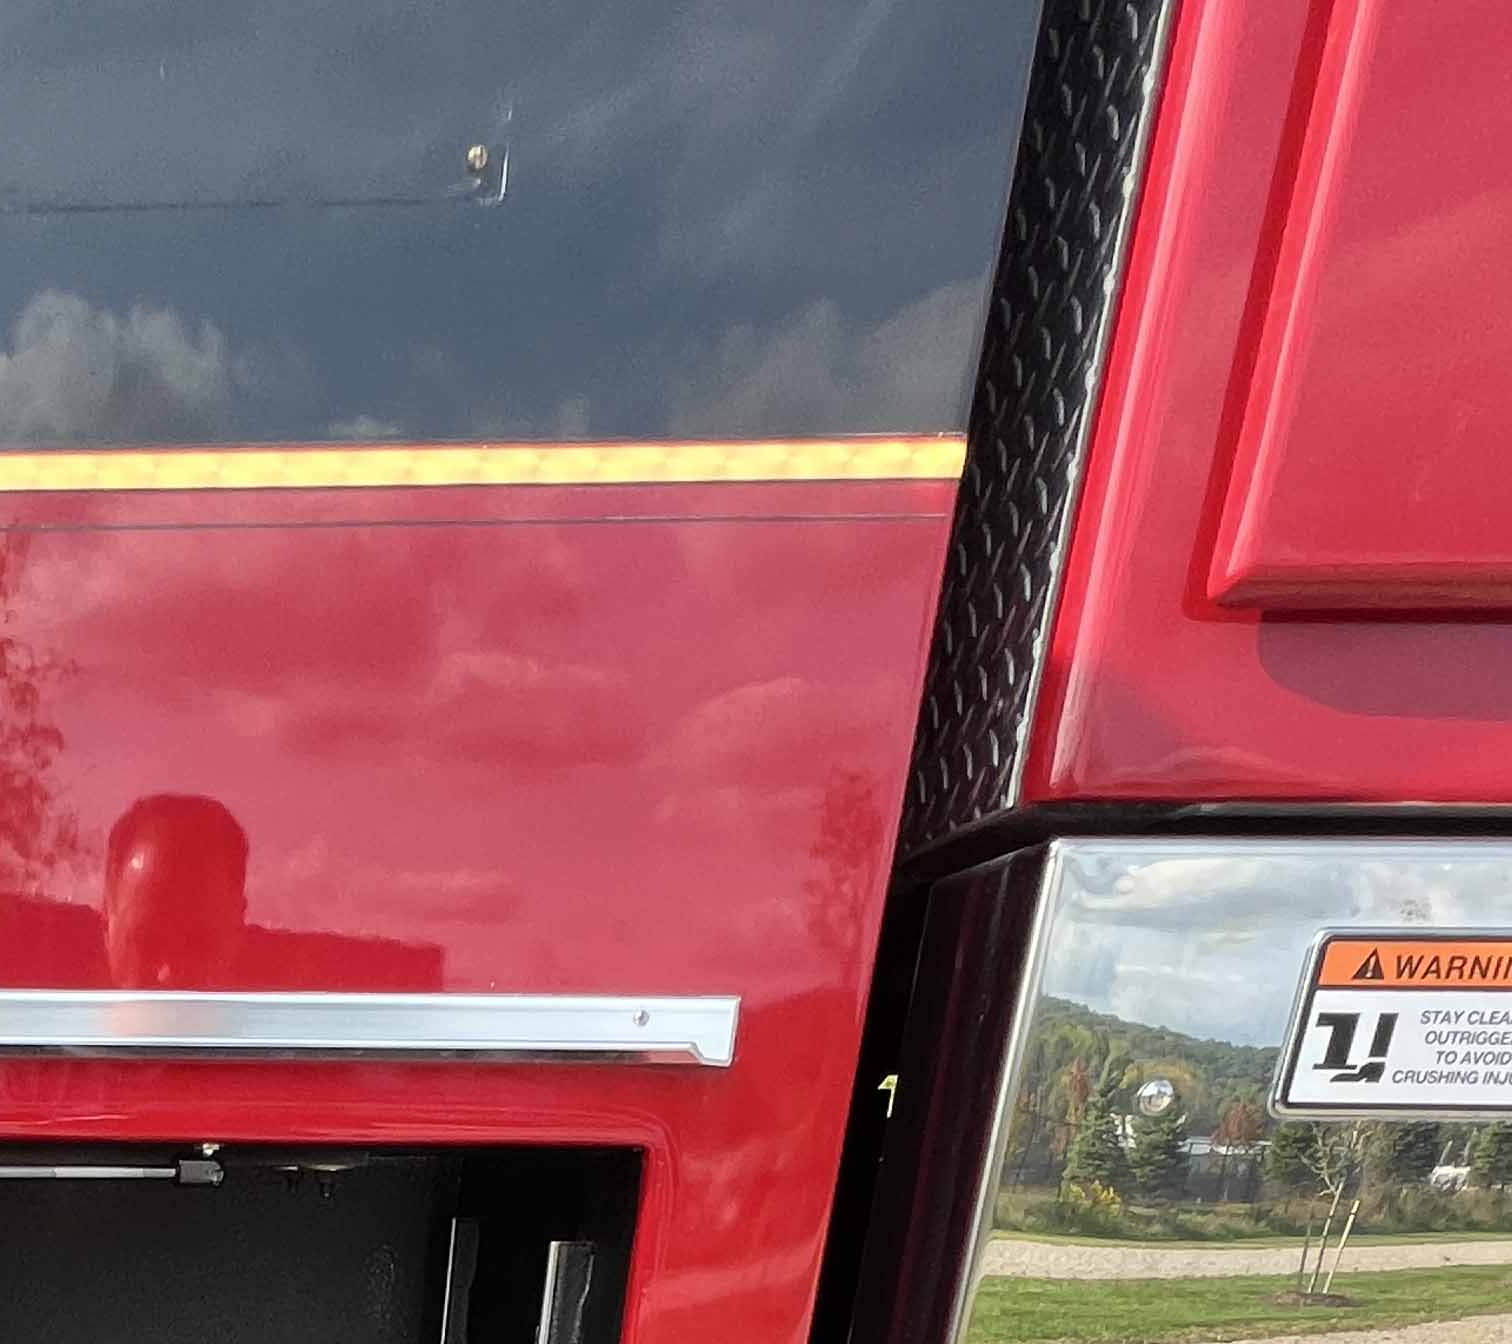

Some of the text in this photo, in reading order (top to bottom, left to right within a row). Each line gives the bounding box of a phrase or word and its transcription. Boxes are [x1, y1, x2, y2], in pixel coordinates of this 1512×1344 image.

[1420, 1010, 1512, 1026] STAY CLEA
[1425, 1030, 1512, 1046] OUTRIGGE
[1436, 1050, 1512, 1066] TO AVOID
[1392, 1070, 1479, 1085] CRUSHING
